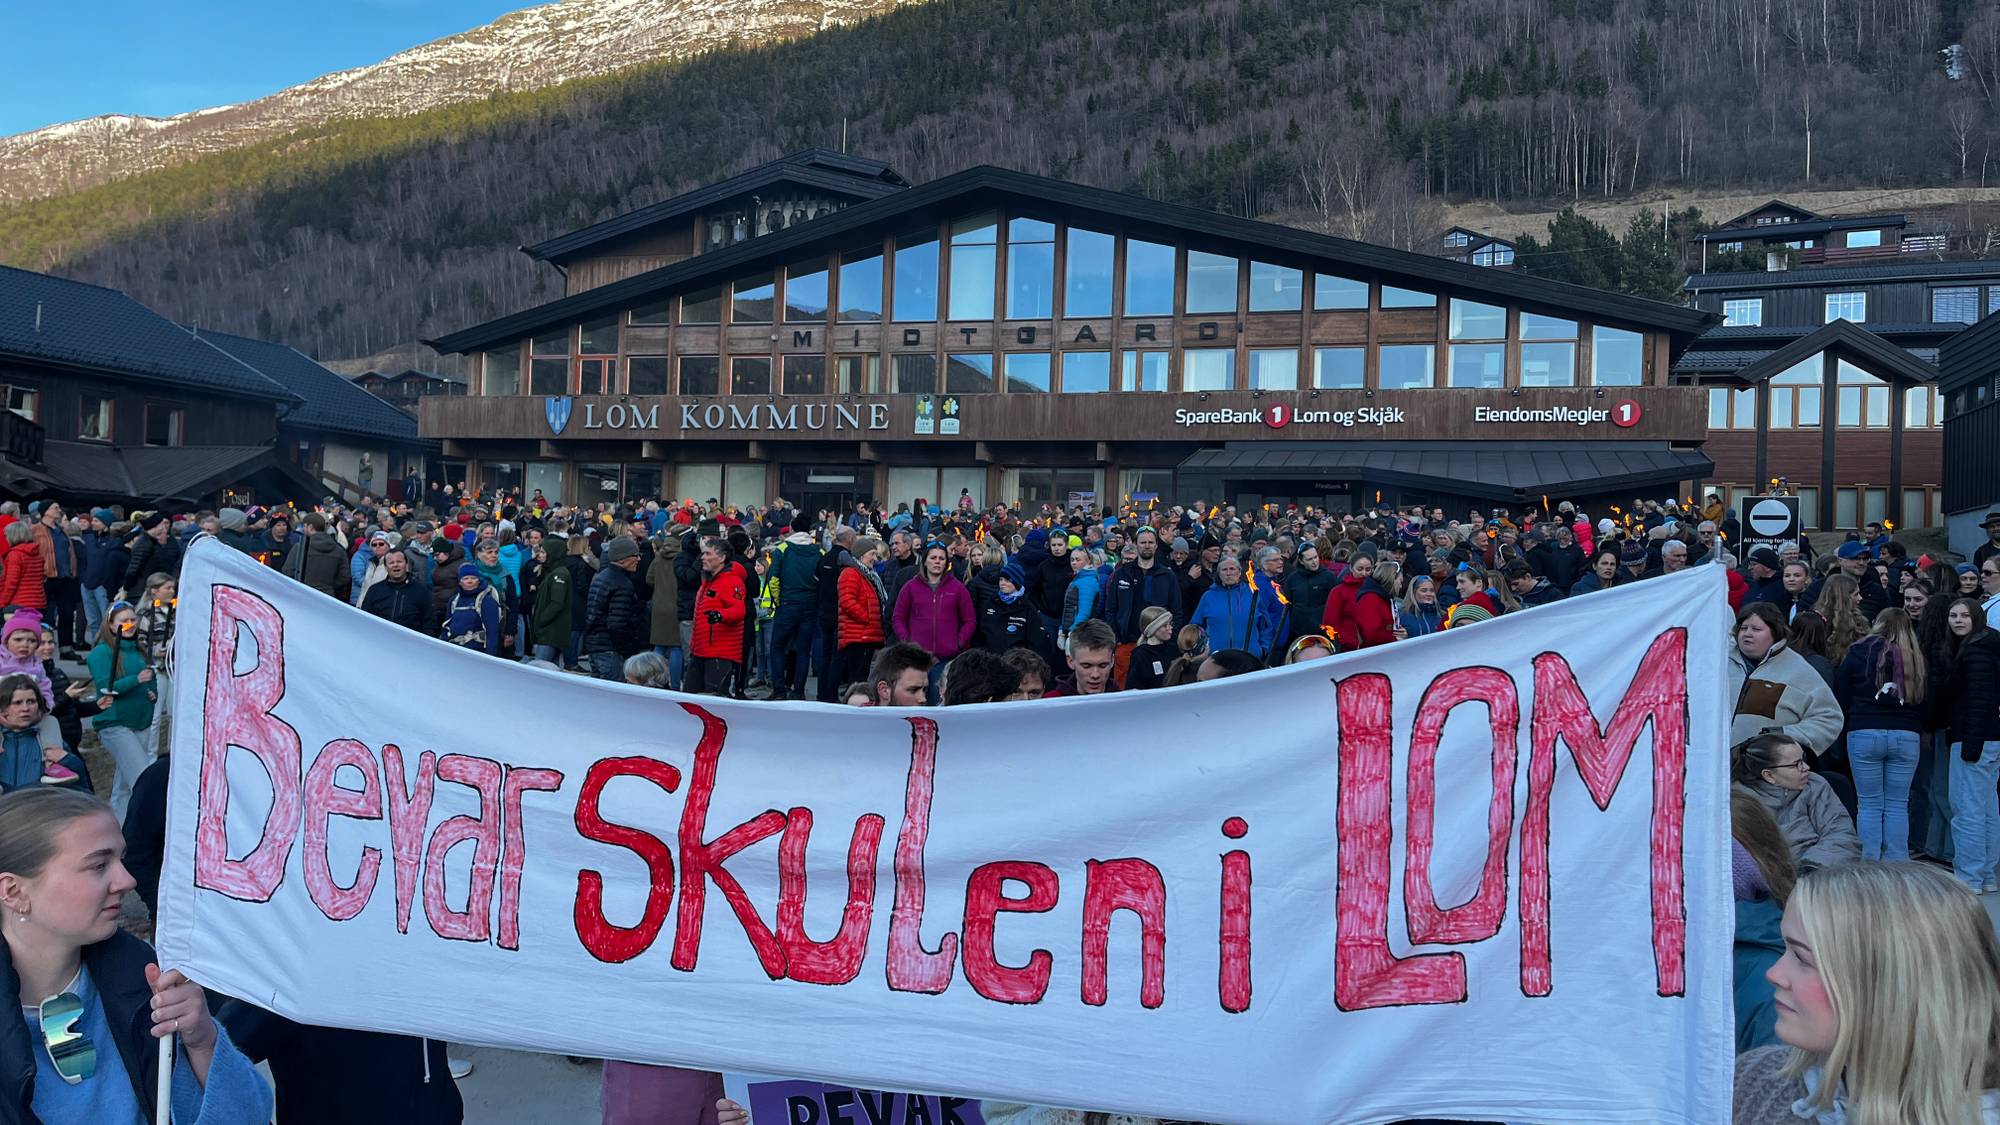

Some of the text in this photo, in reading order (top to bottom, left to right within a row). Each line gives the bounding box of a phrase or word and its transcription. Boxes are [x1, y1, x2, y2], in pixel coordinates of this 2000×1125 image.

[793, 321, 1219, 348] MIDTGARD
[584, 403, 659, 430] LOM
[681, 403, 890, 430] KOMMUNE
[1175, 408, 1262, 427] SpareBank
[1293, 408, 1330, 423] Lom
[1333, 410, 1354, 426] og
[1357, 406, 1405, 426] Skjåk
[1475, 406, 1609, 426] EiendomsMegler
[195, 583, 565, 952] Bevar
[1218, 816, 1252, 1014] i
[1331, 626, 1690, 1012] LOM
